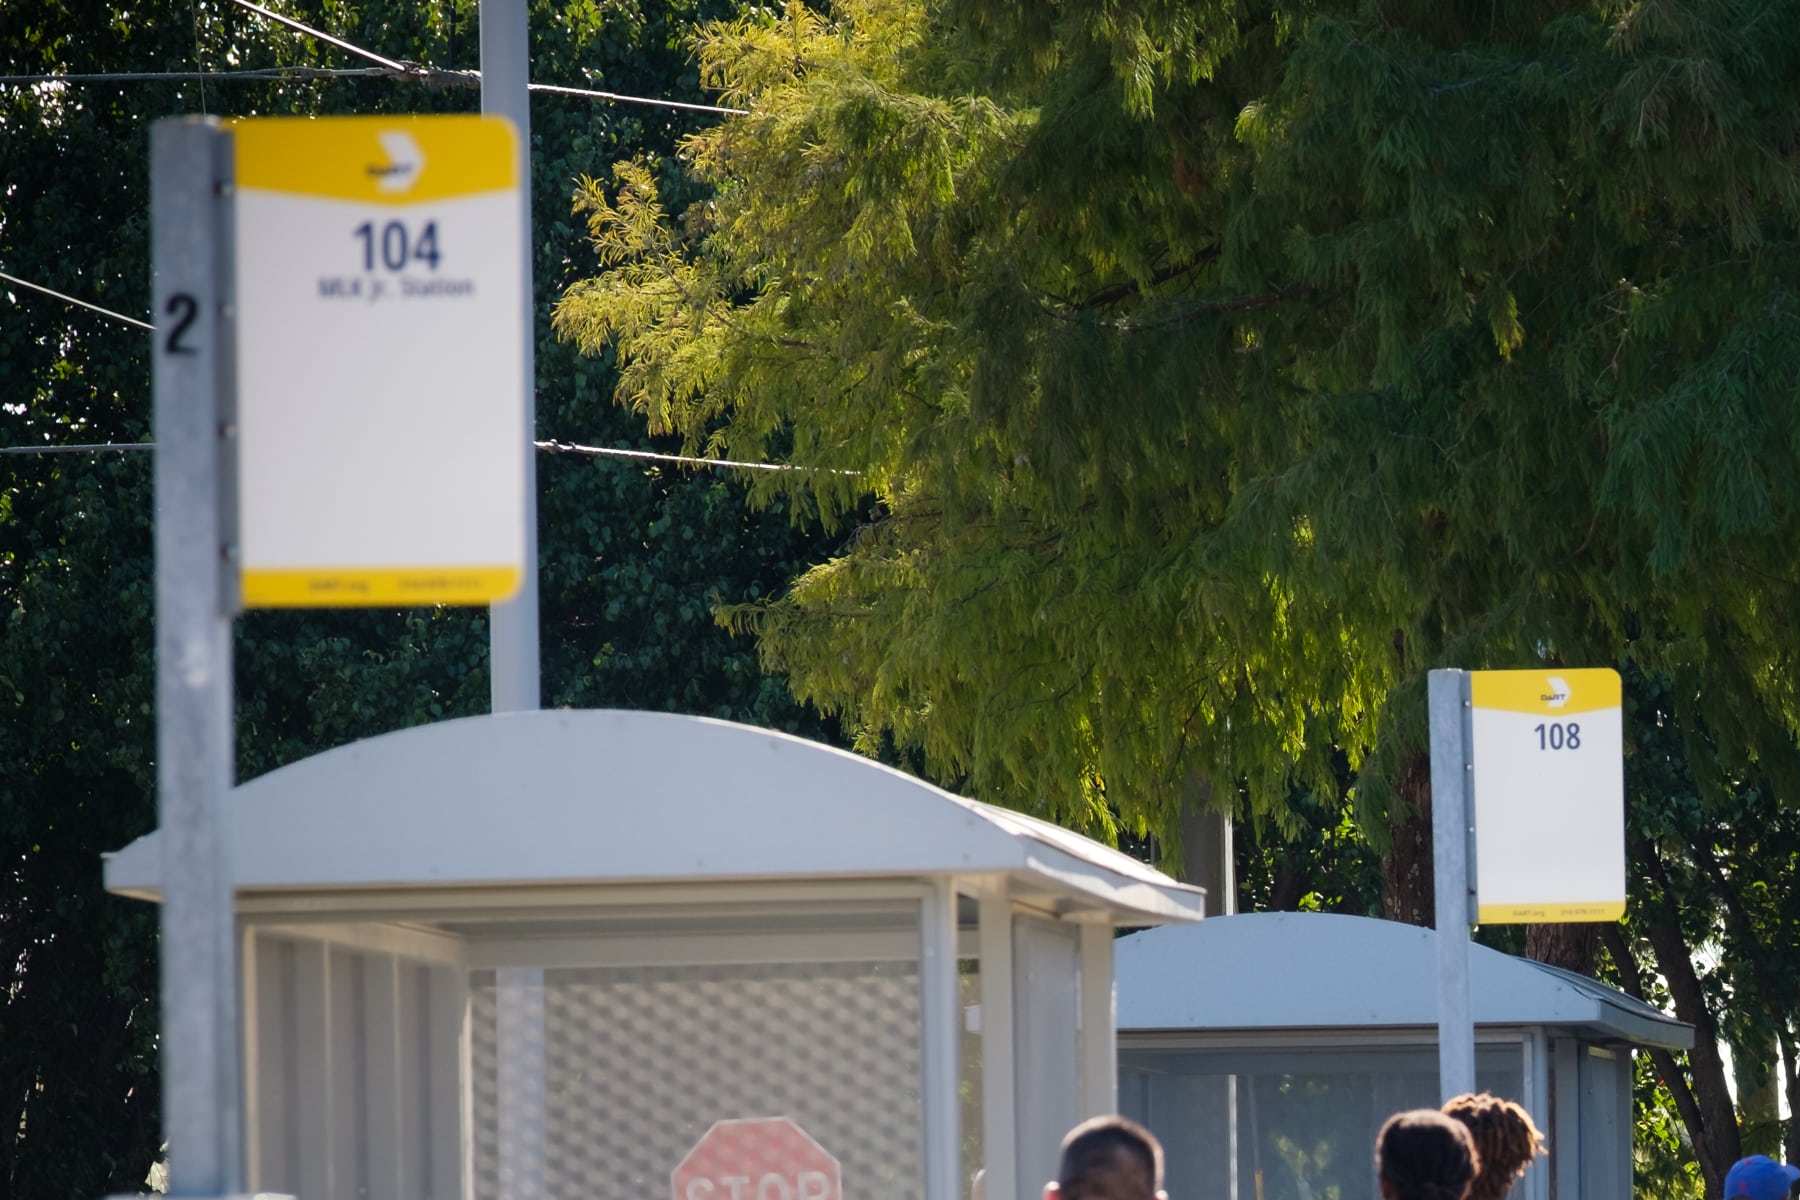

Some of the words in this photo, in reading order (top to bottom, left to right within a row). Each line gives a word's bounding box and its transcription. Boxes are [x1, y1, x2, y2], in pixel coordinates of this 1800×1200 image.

[354, 220, 443, 272] 104
[164, 292, 199, 355] 2
[1534, 722, 1581, 750] 108
